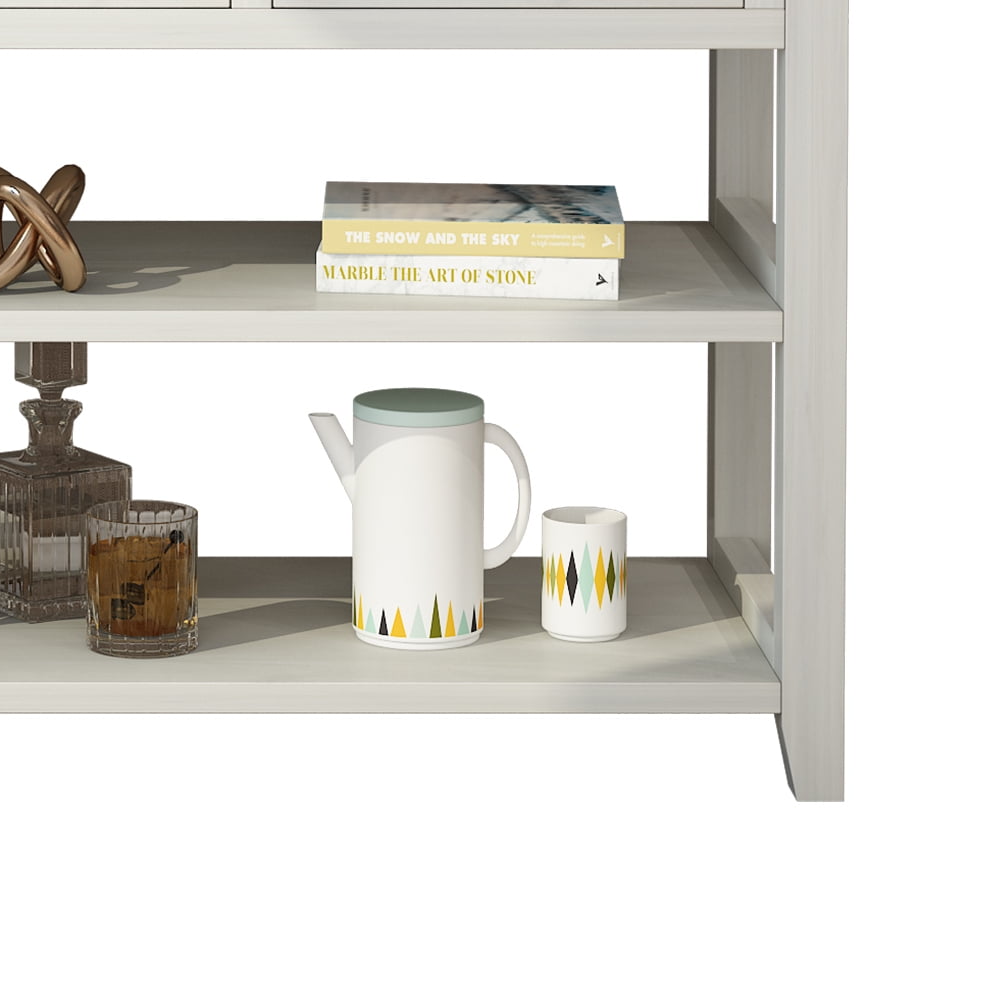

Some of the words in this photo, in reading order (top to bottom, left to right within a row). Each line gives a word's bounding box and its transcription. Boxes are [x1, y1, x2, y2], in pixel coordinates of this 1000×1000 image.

[345, 231, 371, 243] THE
[375, 231, 420, 244] SNOW
[425, 232, 456, 245] AND
[461, 233, 487, 246] THE
[491, 233, 520, 246] SKY
[322, 265, 388, 281] MARBLE
[391, 267, 422, 282] THE
[426, 268, 458, 283] ART
[461, 269, 482, 284] OF
[485, 269, 537, 285] STONE
